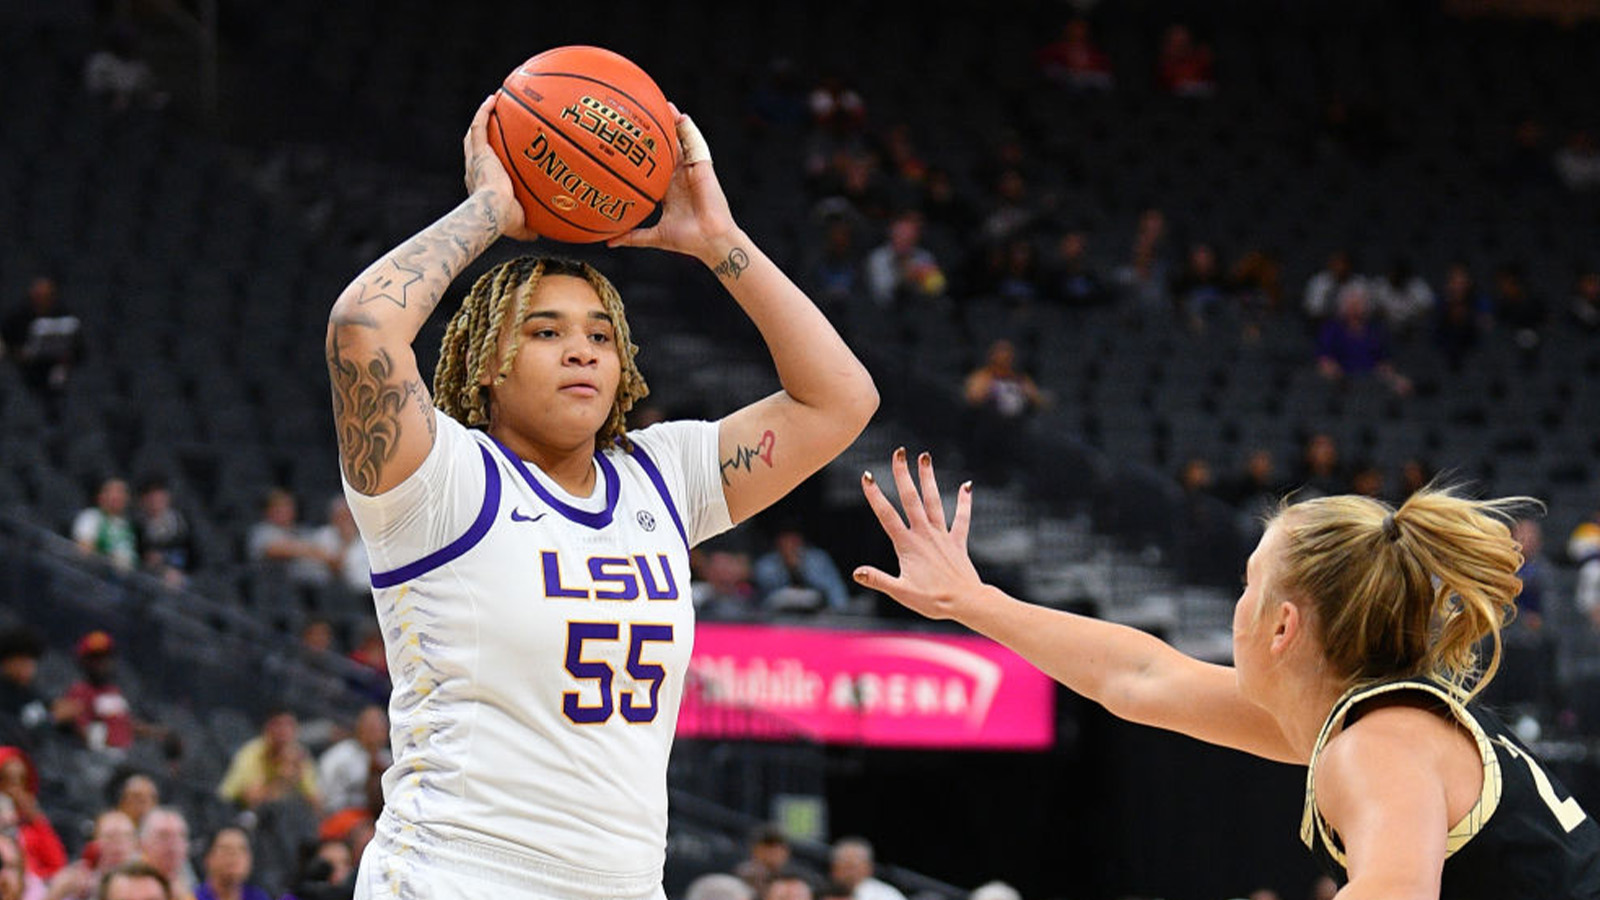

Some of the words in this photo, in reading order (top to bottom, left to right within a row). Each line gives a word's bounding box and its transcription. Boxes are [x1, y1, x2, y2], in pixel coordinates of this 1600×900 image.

[523, 132, 635, 222] SPALDING
[562, 104, 657, 179] LEGACY
[540, 550, 679, 601] LSU
[562, 620, 674, 724] 55
[828, 673, 970, 716] ARENA
